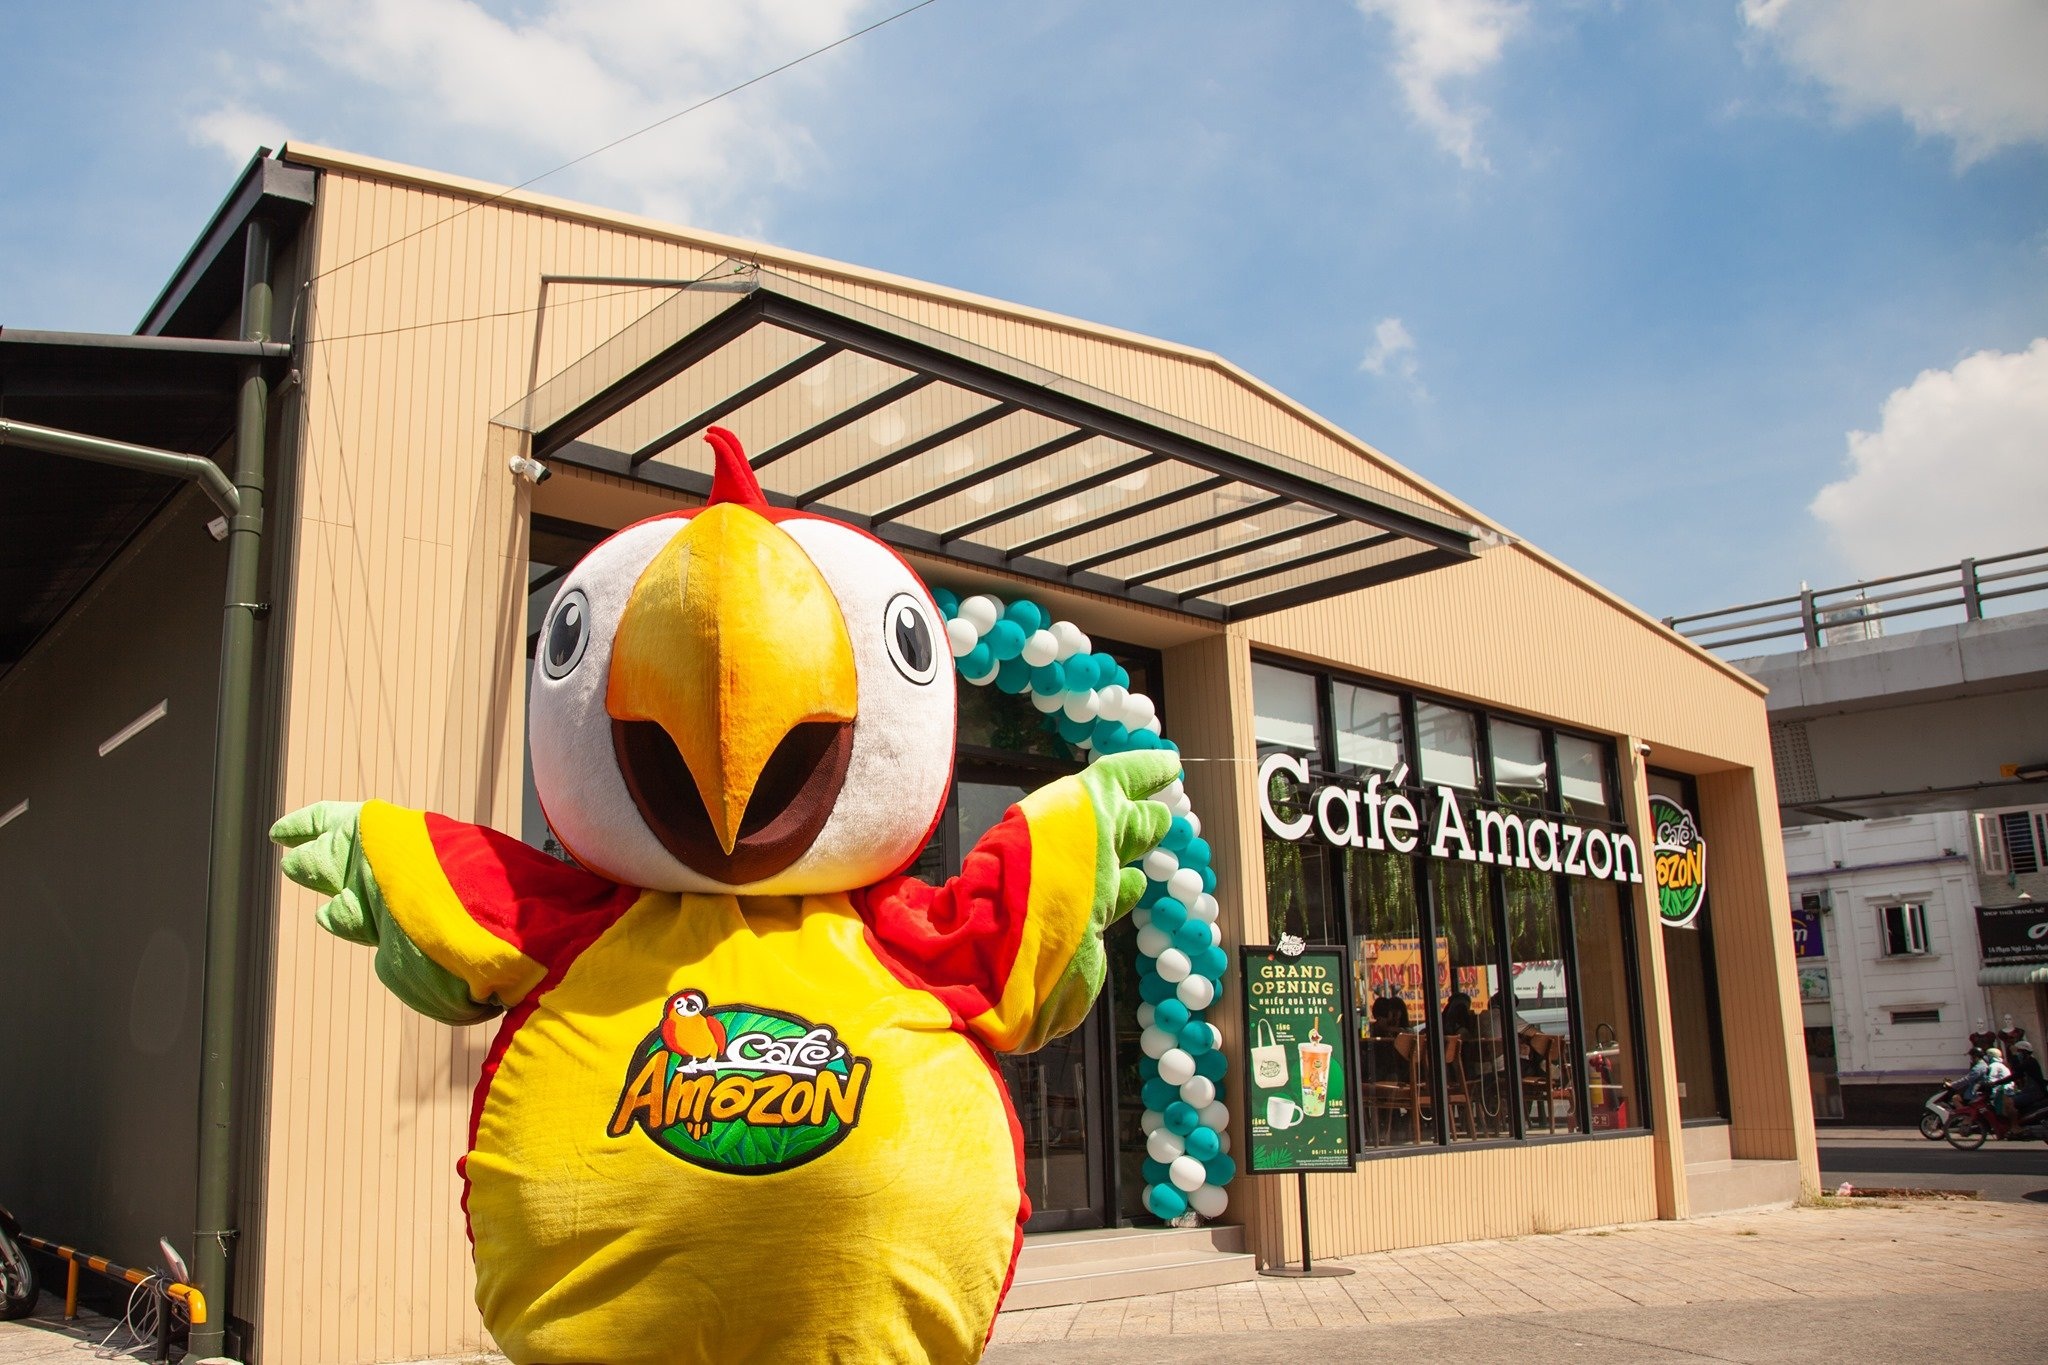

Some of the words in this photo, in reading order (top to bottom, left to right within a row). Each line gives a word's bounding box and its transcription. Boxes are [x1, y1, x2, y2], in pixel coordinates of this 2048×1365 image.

[1258, 753, 1419, 853] Café
[1431, 786, 1643, 884] Amazon
[1657, 816, 1694, 846] Café
[1261, 965, 1326, 979] GRAND
[1252, 980, 1334, 995] OPENING
[726, 1028, 846, 1065] Café
